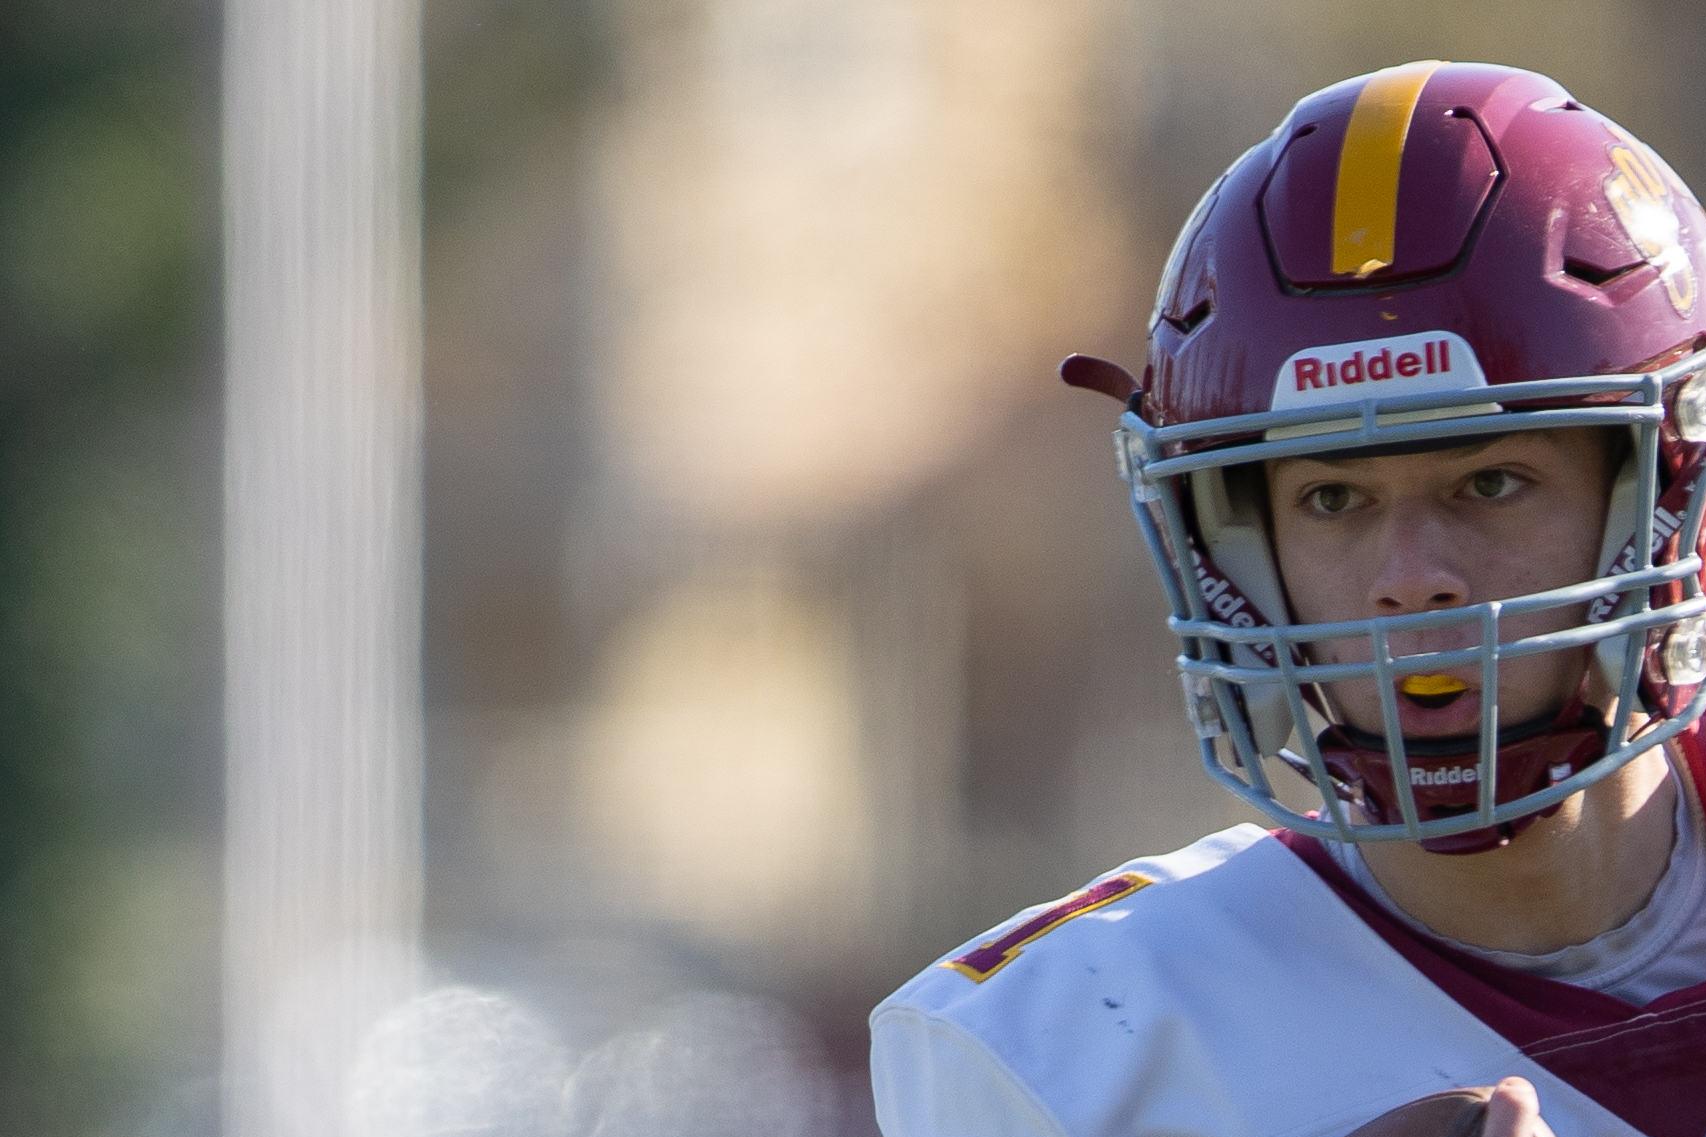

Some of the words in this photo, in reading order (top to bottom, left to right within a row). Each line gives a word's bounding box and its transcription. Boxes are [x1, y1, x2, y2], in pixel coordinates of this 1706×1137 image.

[1293, 339, 1451, 392] Riddell
[1409, 763, 1483, 786] Riddel
[937, 871, 1155, 985] 1
